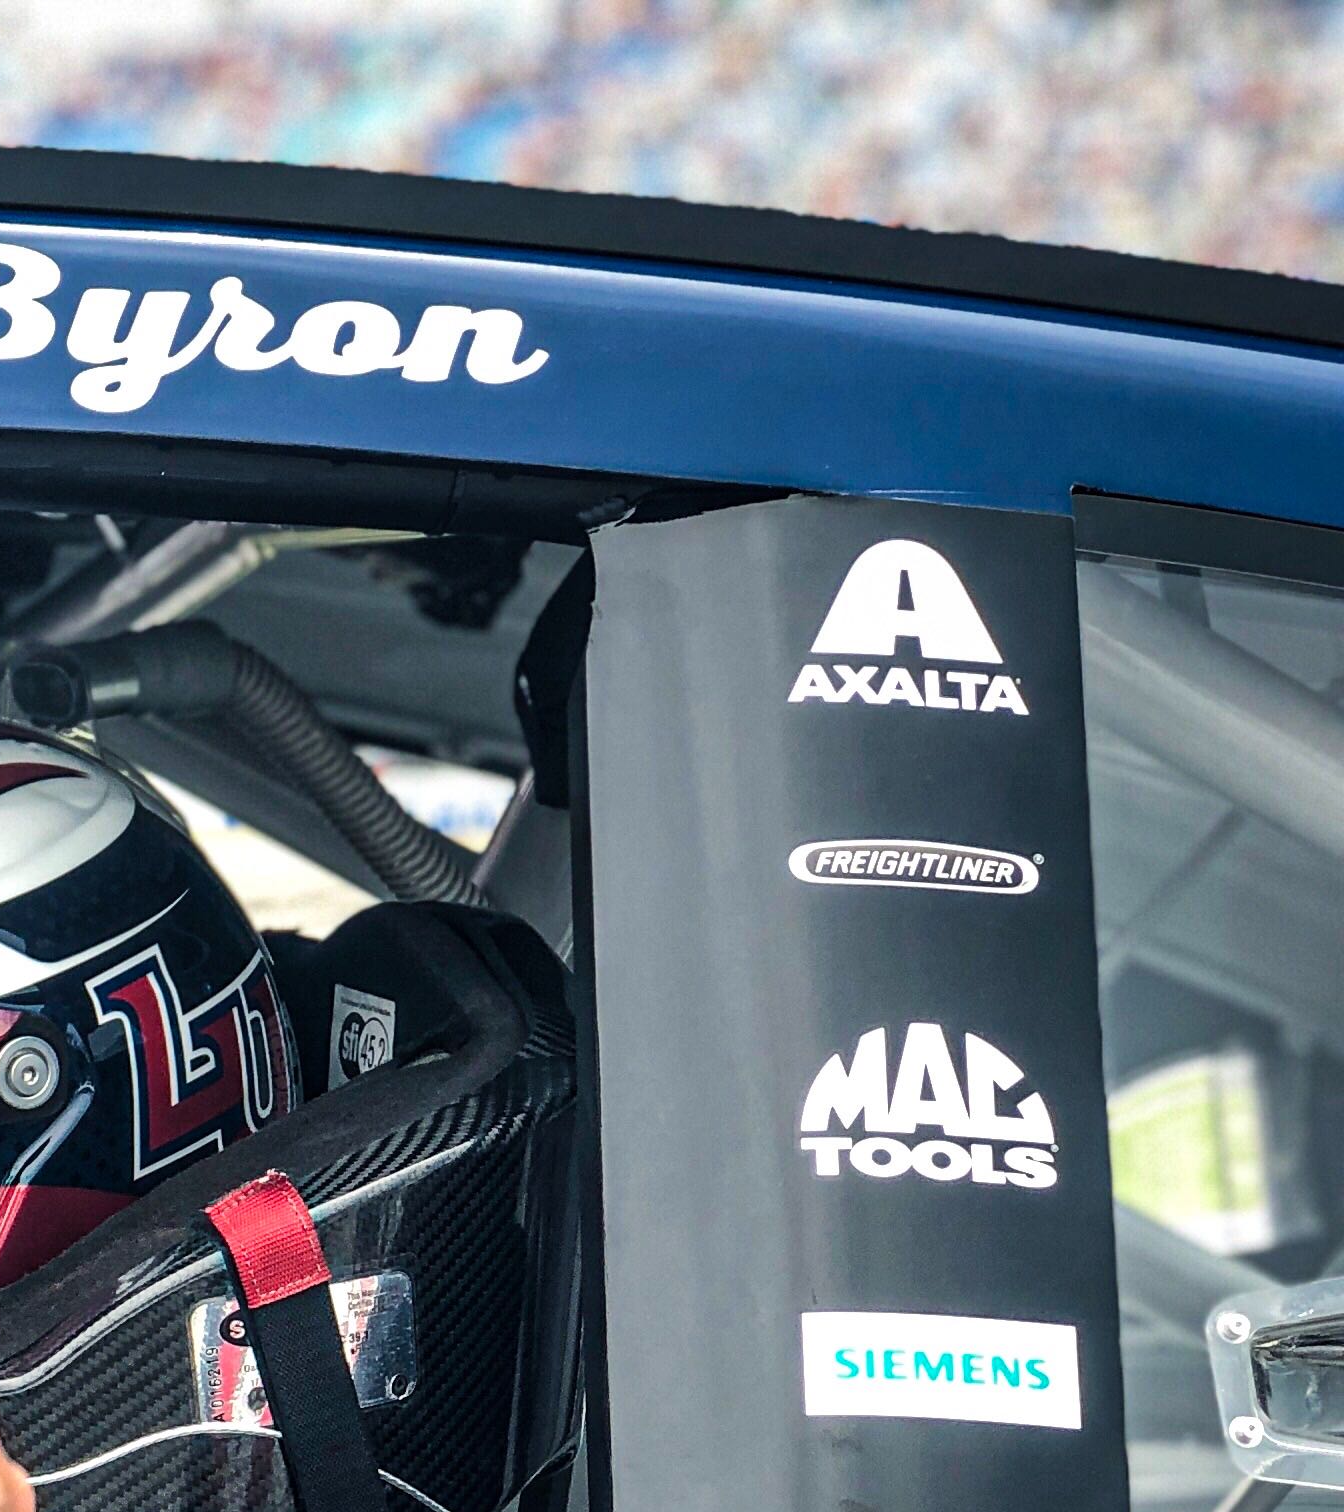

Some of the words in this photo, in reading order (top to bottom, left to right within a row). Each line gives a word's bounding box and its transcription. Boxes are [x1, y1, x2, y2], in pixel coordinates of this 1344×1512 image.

[787, 664, 1030, 716] AXALTA
[814, 850, 1015, 885] FREIGHTLINER
[799, 1022, 1055, 1144] MAC
[799, 1136, 1058, 1189] TOOLS
[834, 1348, 1050, 1391] SIEMENS
